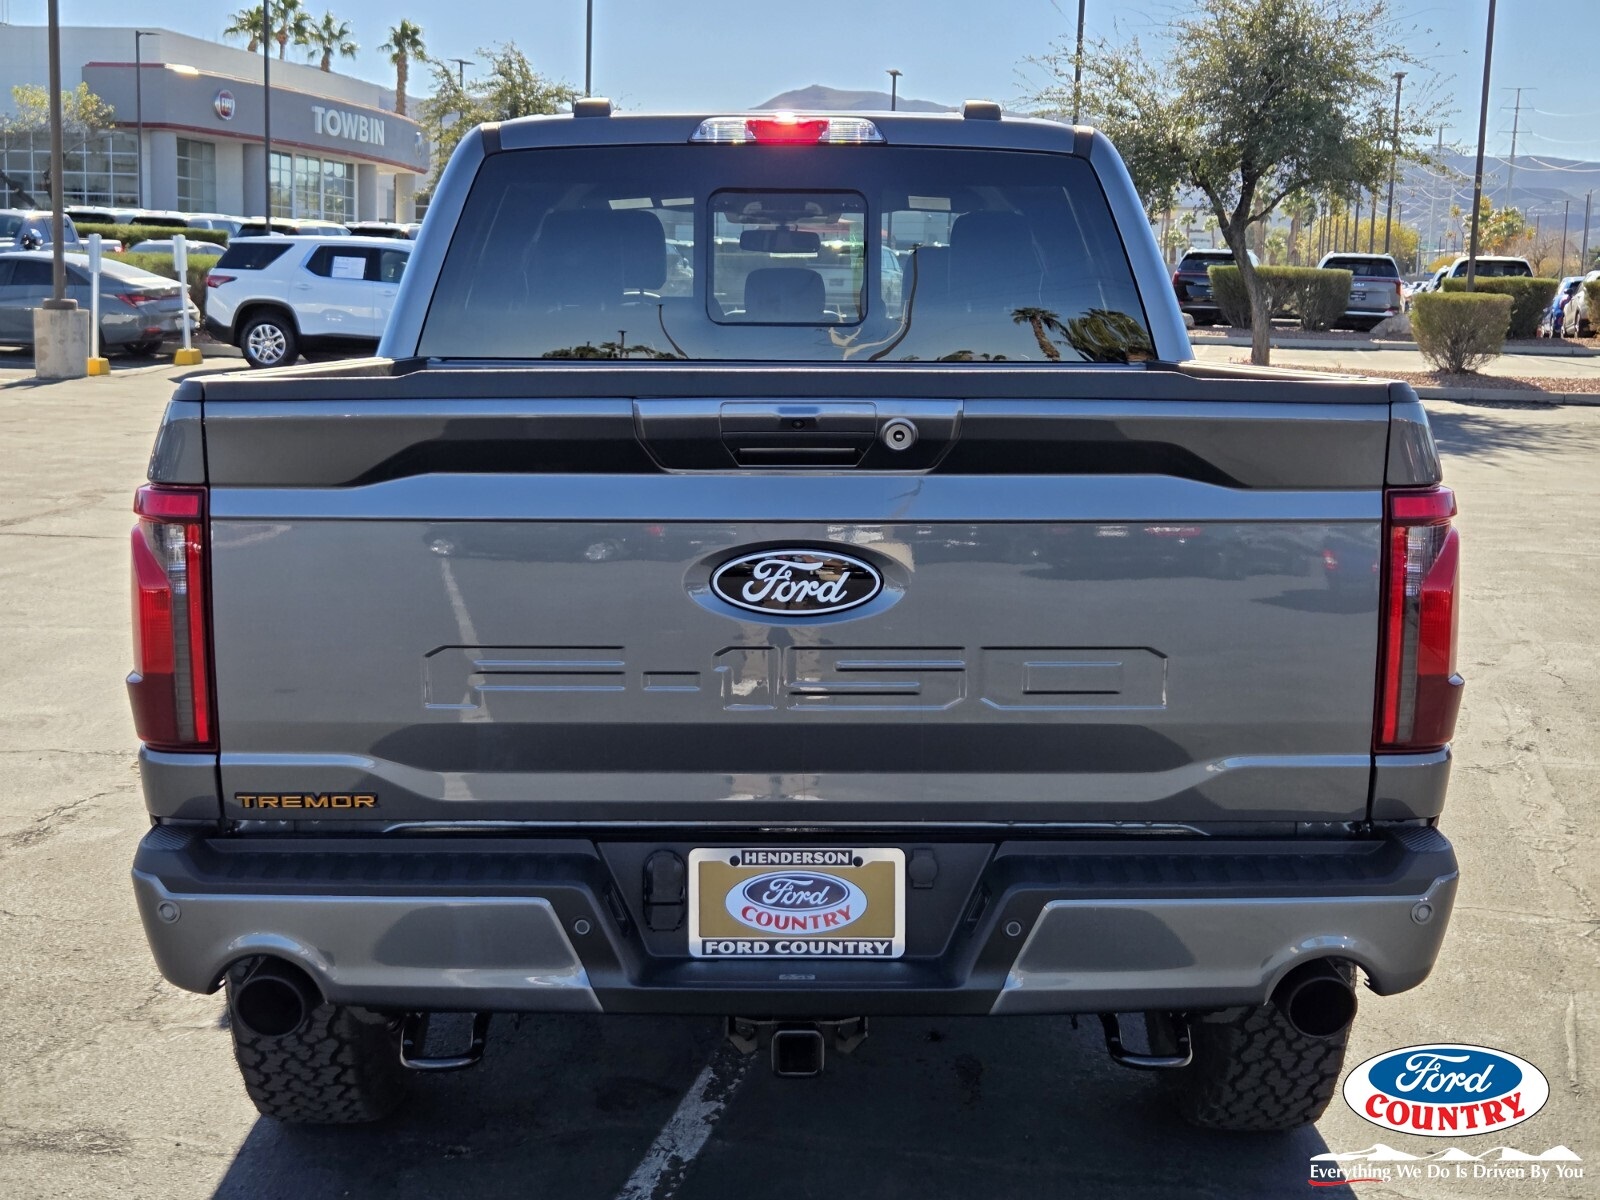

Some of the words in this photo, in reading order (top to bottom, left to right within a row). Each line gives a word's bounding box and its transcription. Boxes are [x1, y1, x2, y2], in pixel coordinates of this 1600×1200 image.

[312, 105, 385, 146] TOWBIN
[742, 559, 850, 603] Ford
[235, 793, 376, 809] TREMOR
[744, 851, 850, 864] HENDERSON
[762, 878, 828, 905] Ford
[741, 904, 852, 931] COUNTRY
[705, 941, 770, 955] FORD
[774, 941, 890, 955] COUNTRY
